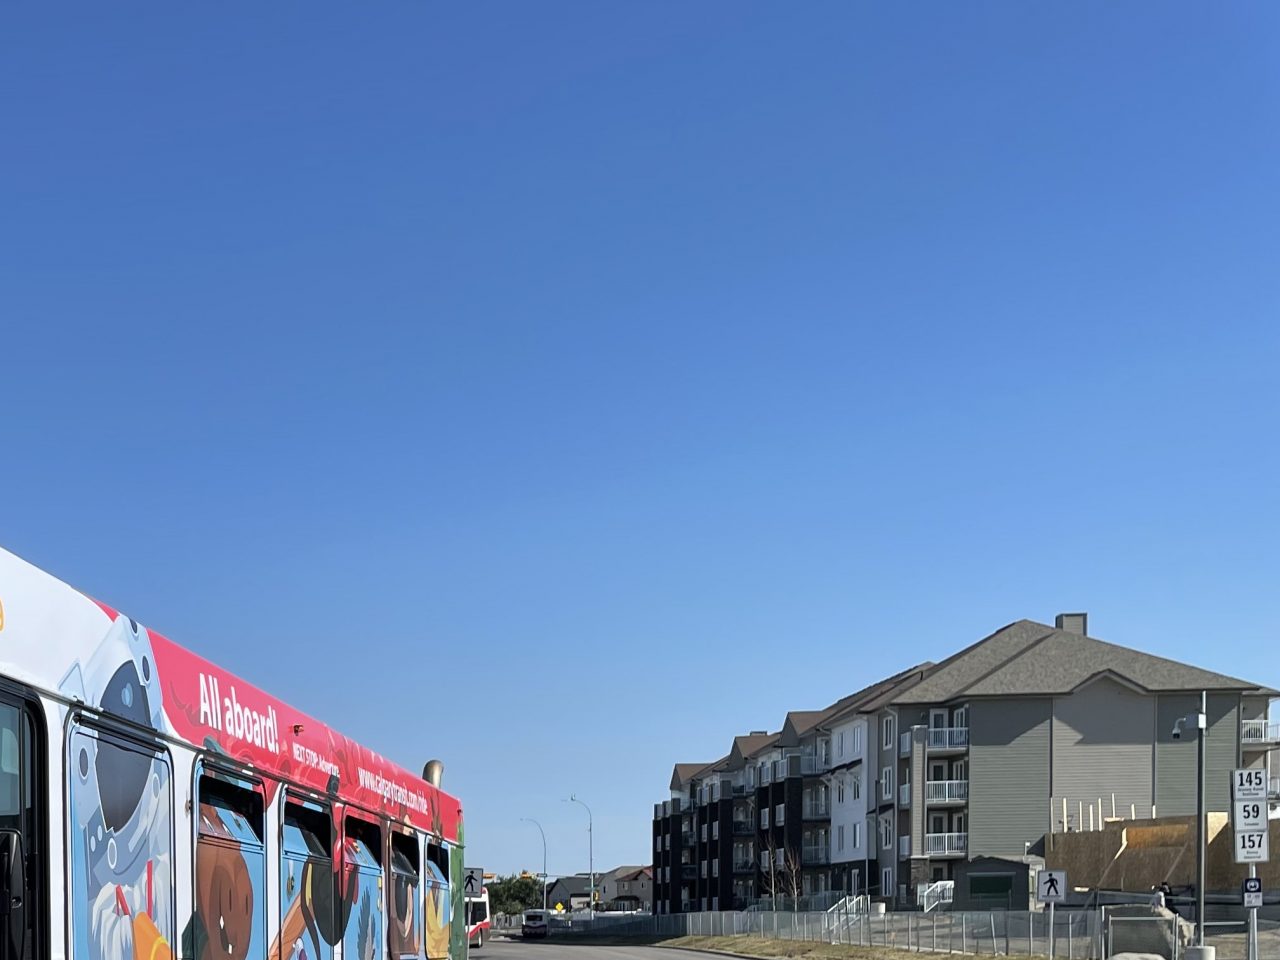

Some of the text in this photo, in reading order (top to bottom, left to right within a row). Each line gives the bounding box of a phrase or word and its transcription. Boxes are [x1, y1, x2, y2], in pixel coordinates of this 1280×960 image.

[198, 673, 279, 754] All aboard!
[292, 742, 306, 764] NEXT
[1238, 771, 1263, 786] 145
[1242, 804, 1260, 819] 59
[1240, 834, 1264, 849] 157
